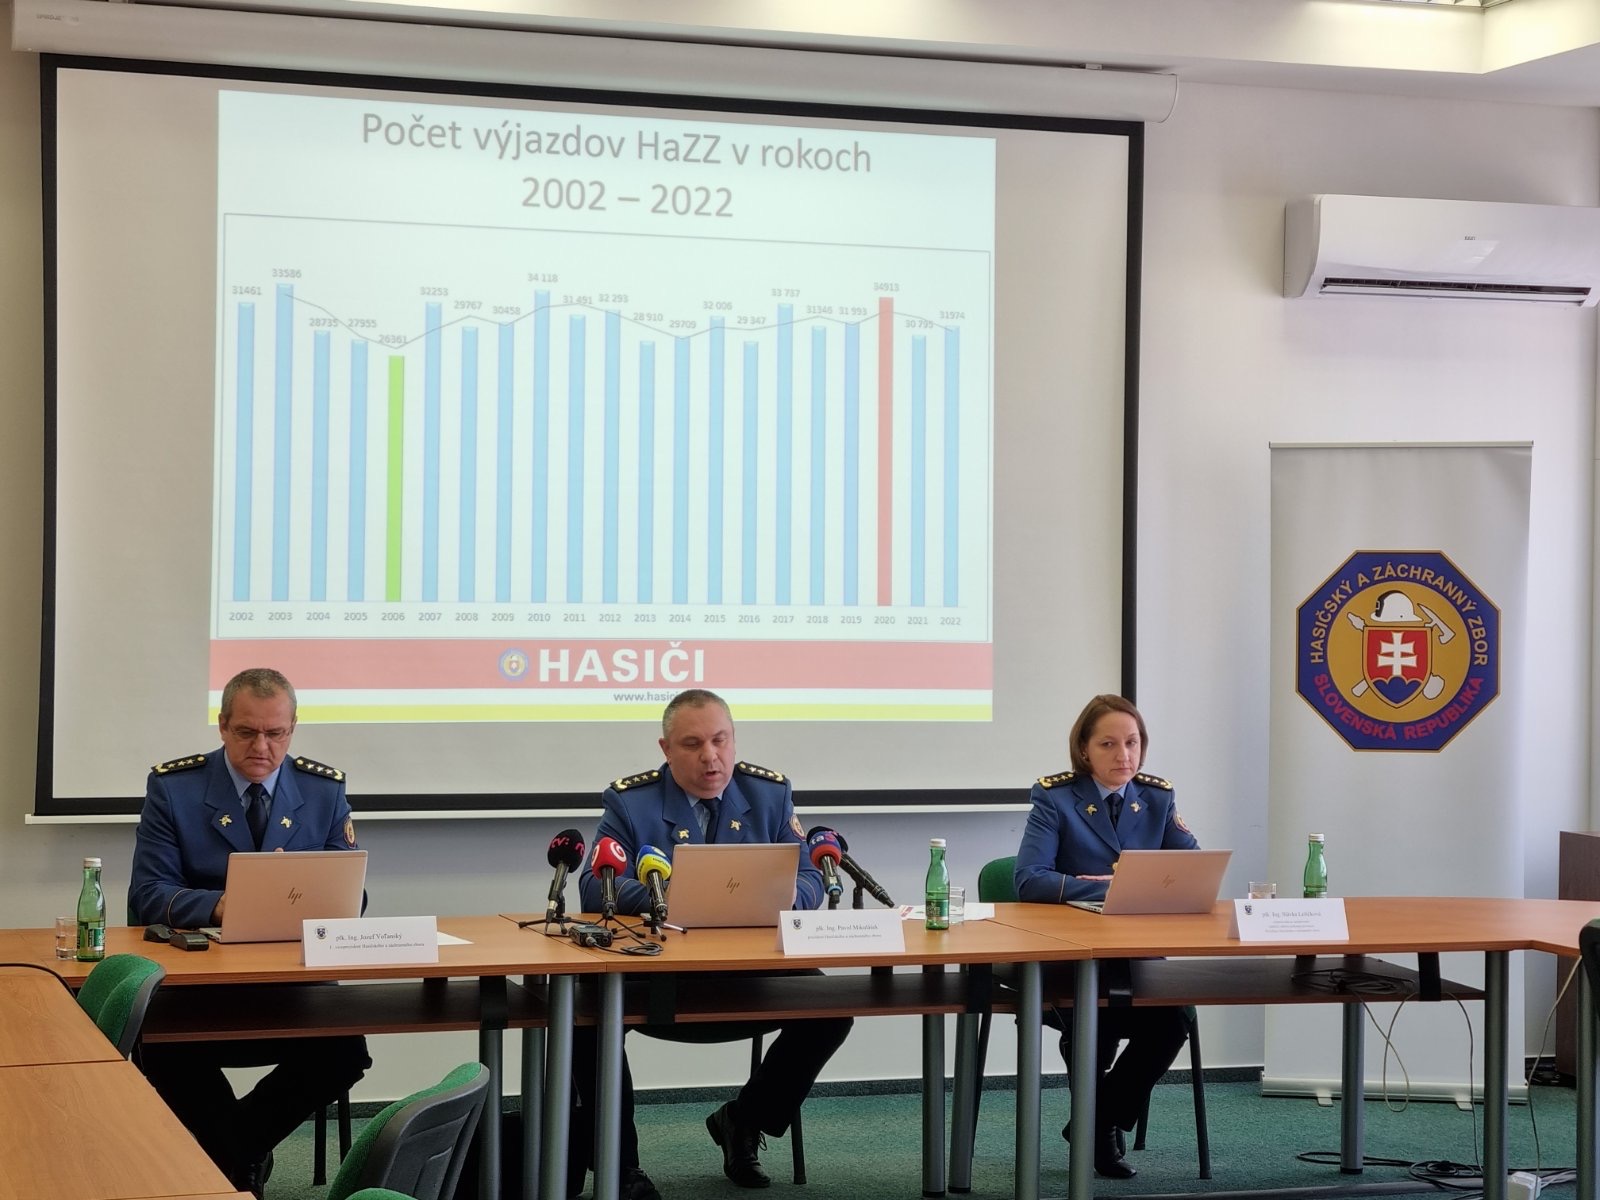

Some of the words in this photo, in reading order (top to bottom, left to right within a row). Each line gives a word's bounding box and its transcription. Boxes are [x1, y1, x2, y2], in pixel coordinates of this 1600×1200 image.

[363, 112, 462, 150] Počet
[473, 120, 625, 160] výjazdov
[638, 130, 721, 164] HaZZ
[732, 143, 750, 165] v
[762, 138, 871, 172] rokoch
[522, 177, 607, 211] 2002
[650, 184, 733, 217] 2022
[272, 268, 302, 279] 33586
[232, 285, 262, 296] 31461
[454, 300, 483, 310] 29767
[492, 305, 521, 315] 30458
[309, 318, 339, 327] 28735
[348, 318, 377, 328] 27955
[669, 319, 697, 329] 29709
[379, 334, 408, 344] 26361
[229, 612, 254, 621] 2002
[268, 612, 293, 621] 2003
[306, 612, 331, 621] 2004
[344, 612, 368, 621] 2005
[381, 612, 406, 621] 2006
[418, 612, 442, 621] 2007
[455, 612, 479, 621] 2008
[491, 613, 514, 622] 2009
[528, 613, 551, 622] 2010
[563, 613, 586, 622] 2011
[599, 613, 621, 622] 2012
[634, 613, 656, 622] 2013
[668, 614, 691, 623] 2014
[703, 614, 726, 623] 2015
[738, 614, 760, 623] 2016
[772, 615, 794, 623] 2017
[806, 615, 828, 624] 2018
[840, 615, 862, 624] 2019
[874, 616, 896, 624] 2020
[907, 616, 928, 625] 2021
[940, 616, 961, 625] 2022
[1310, 579, 1353, 664] HASIČSKÝ
[1357, 572, 1370, 587] A
[1372, 561, 1477, 613] ZÁCHRANNÝ
[1467, 615, 1489, 666] ZBOR
[539, 641, 704, 682] HASIČI
[613, 691, 679, 702] www.hasic
[1313, 673, 1397, 740] SLOVENSKÁ
[1403, 677, 1484, 740] REPUBLIKA
